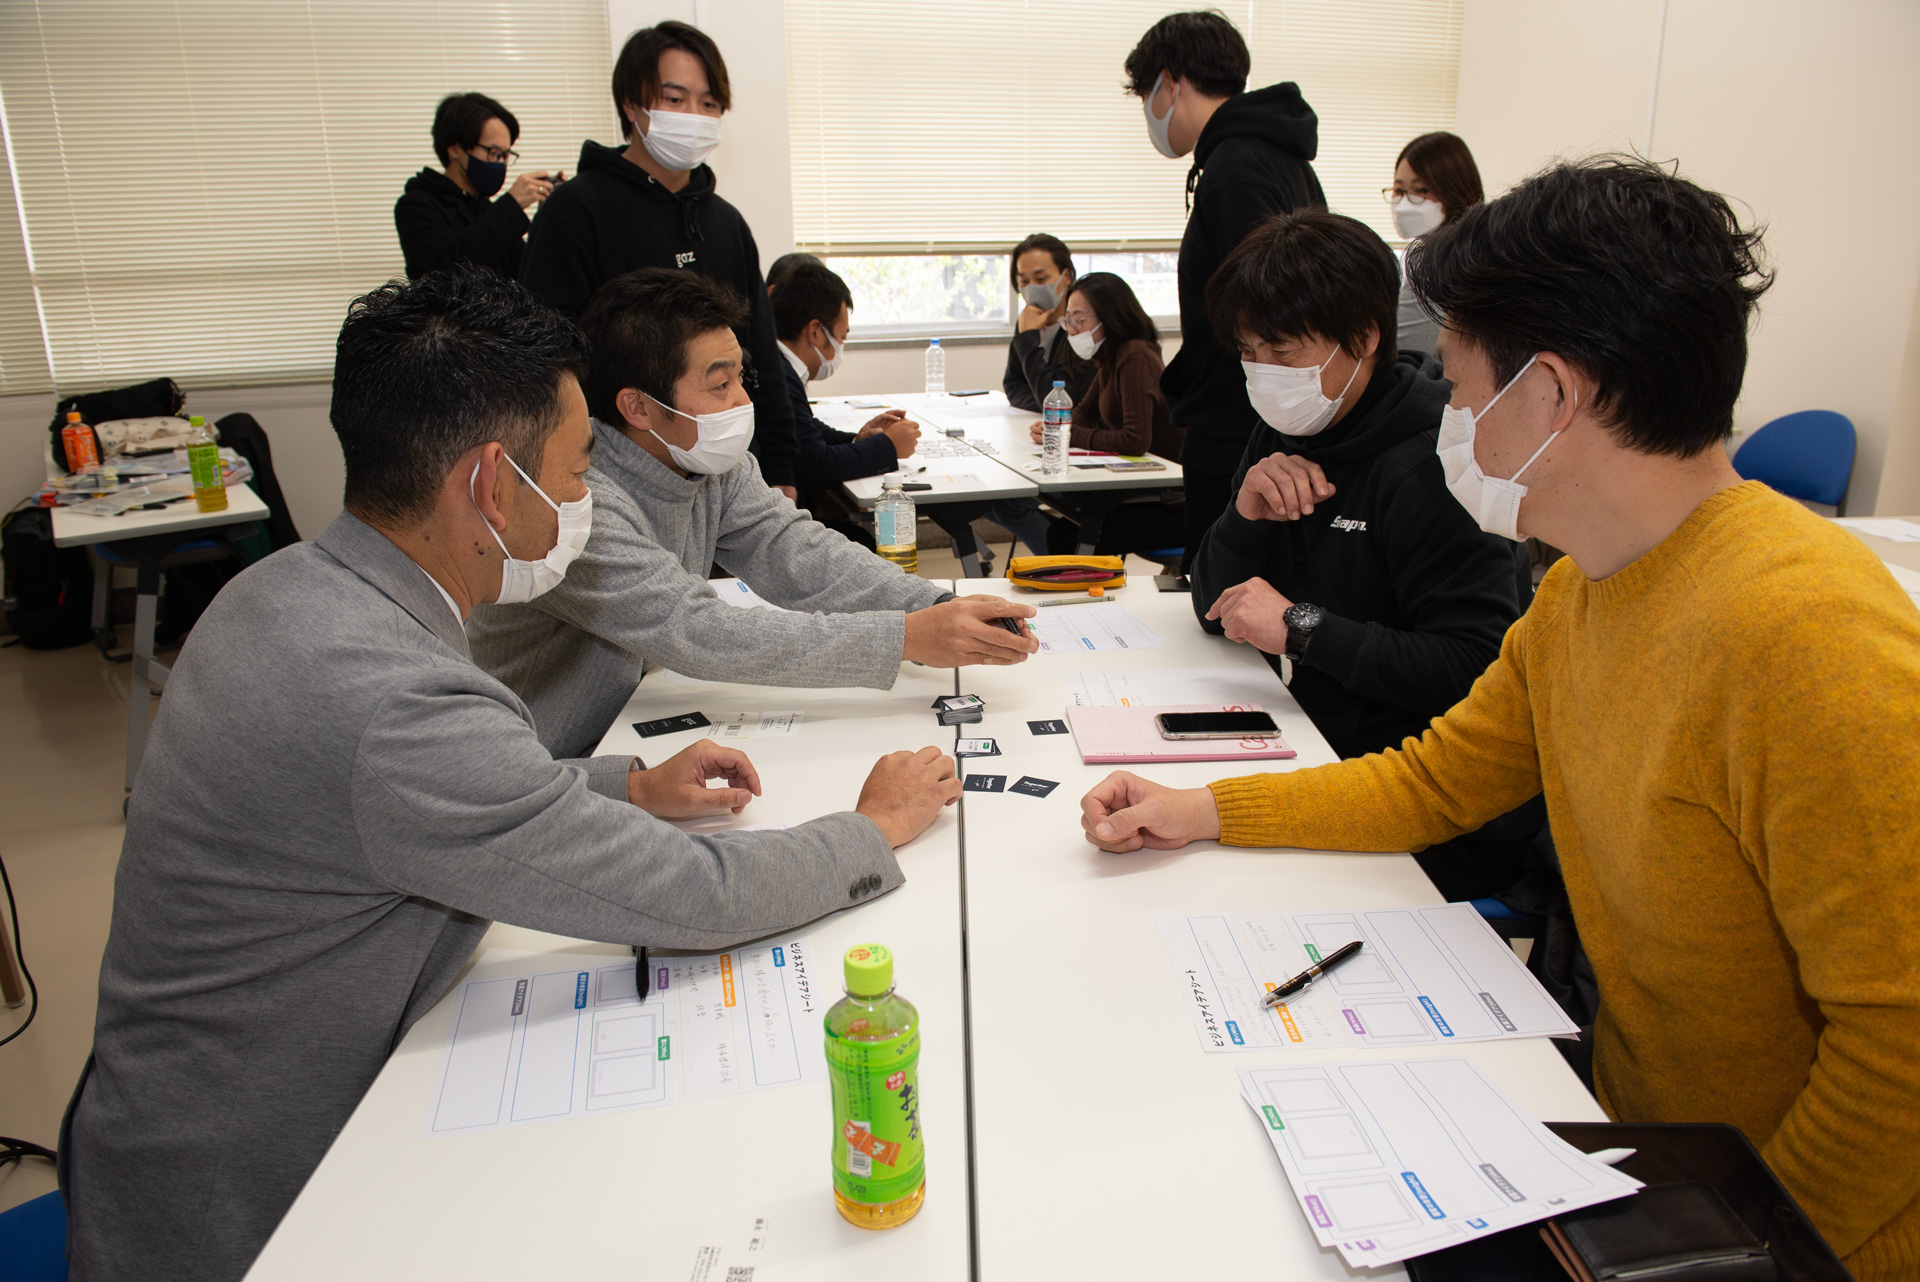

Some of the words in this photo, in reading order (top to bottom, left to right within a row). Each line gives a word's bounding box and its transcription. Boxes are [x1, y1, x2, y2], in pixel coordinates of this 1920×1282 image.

[790, 942, 814, 1012] ビジネスアイデアシート
[1185, 969, 1224, 1047] ビジネスアイデアシート
